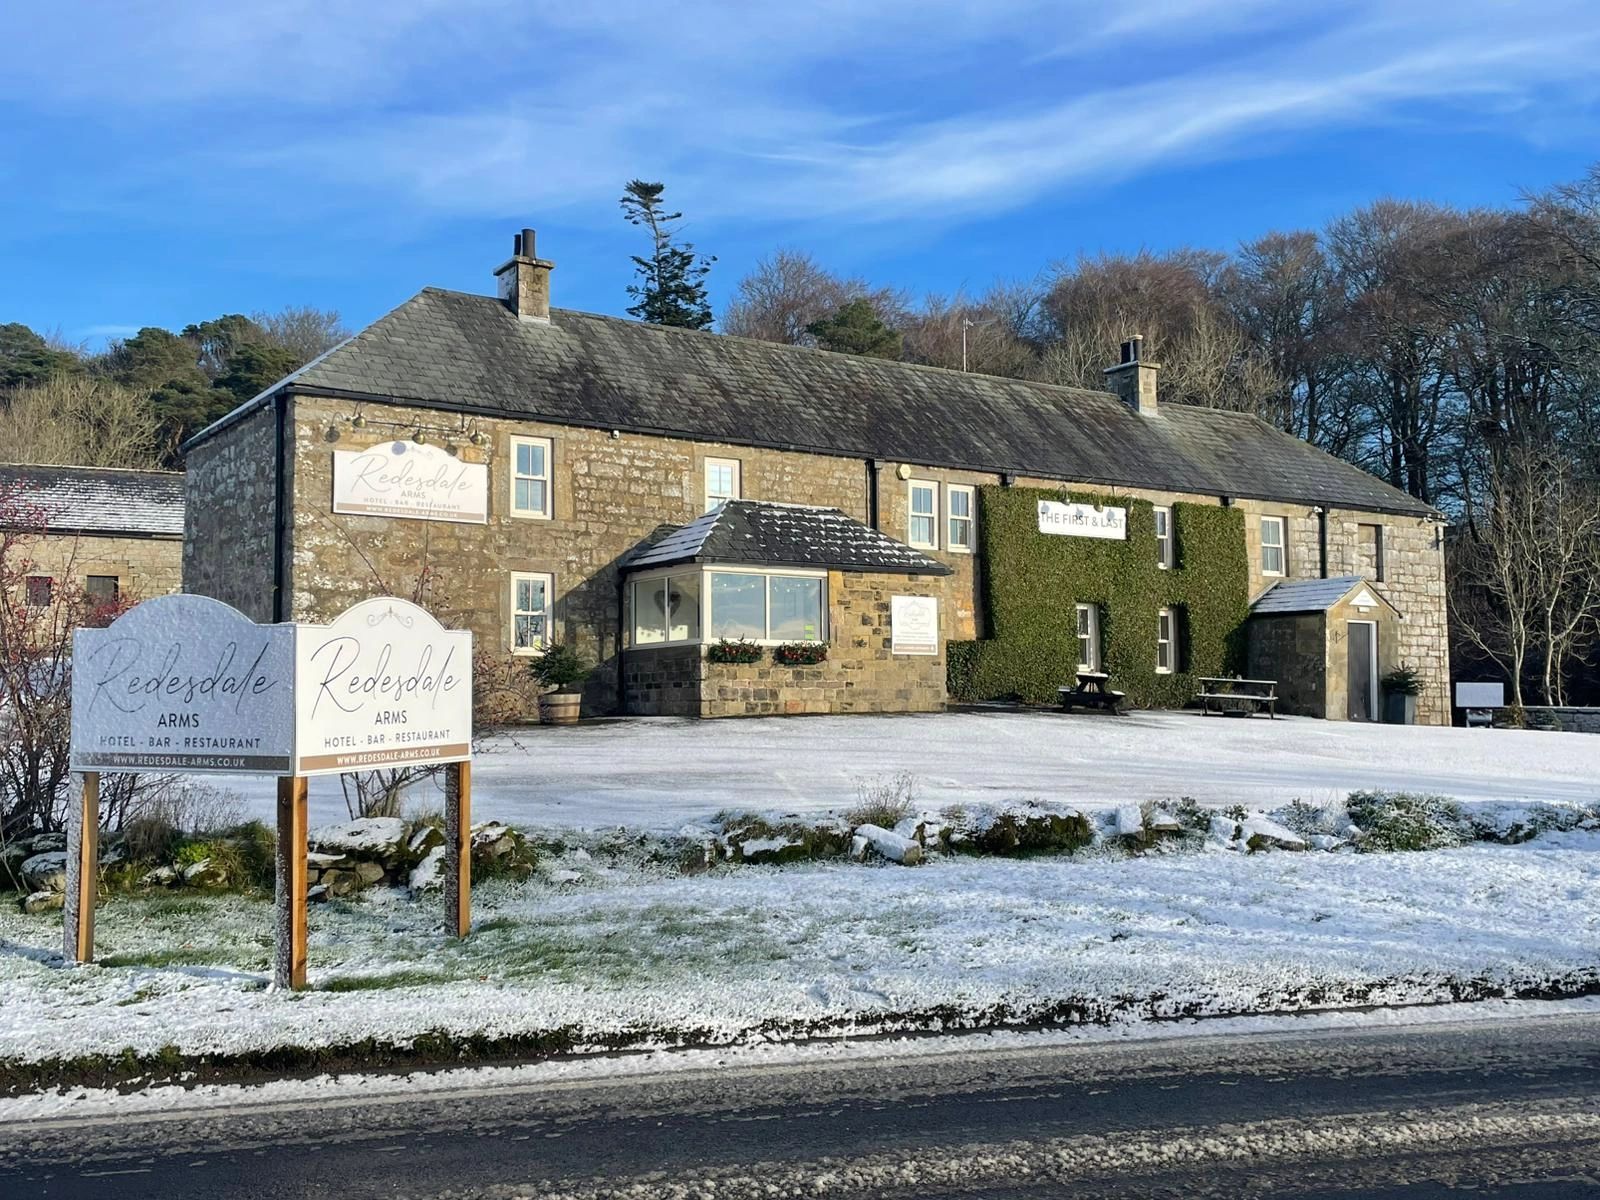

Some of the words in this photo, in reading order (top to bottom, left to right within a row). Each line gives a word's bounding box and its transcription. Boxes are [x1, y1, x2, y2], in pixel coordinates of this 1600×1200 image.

[350, 453, 473, 499] Redesdale
[363, 497, 388, 505] HOTEL
[394, 498, 409, 506] BAR
[400, 490, 426, 499] ARMS
[1040, 511, 1060, 524] THE
[1062, 513, 1089, 527] FIRST
[1091, 517, 1099, 527] &
[1100, 517, 1123, 529] LAST
[88, 637, 278, 715] Redesdale
[310, 636, 462, 720] Redesdale
[157, 713, 200, 729] ARMS
[374, 710, 408, 725] ARMS
[100, 736, 136, 747] HOTEL
[148, 736, 171, 748] BAR
[184, 737, 261, 749] RESTAURANT
[324, 736, 357, 748] HOTEL
[367, 733, 385, 744] BAR
[395, 729, 451, 743] RESTAURANT
[113, 756, 245, 768] WWW.REDESDALE-ARMS.CO.UK
[336, 748, 441, 766] WWW.REDESDALE-ARMS.CO.UK
